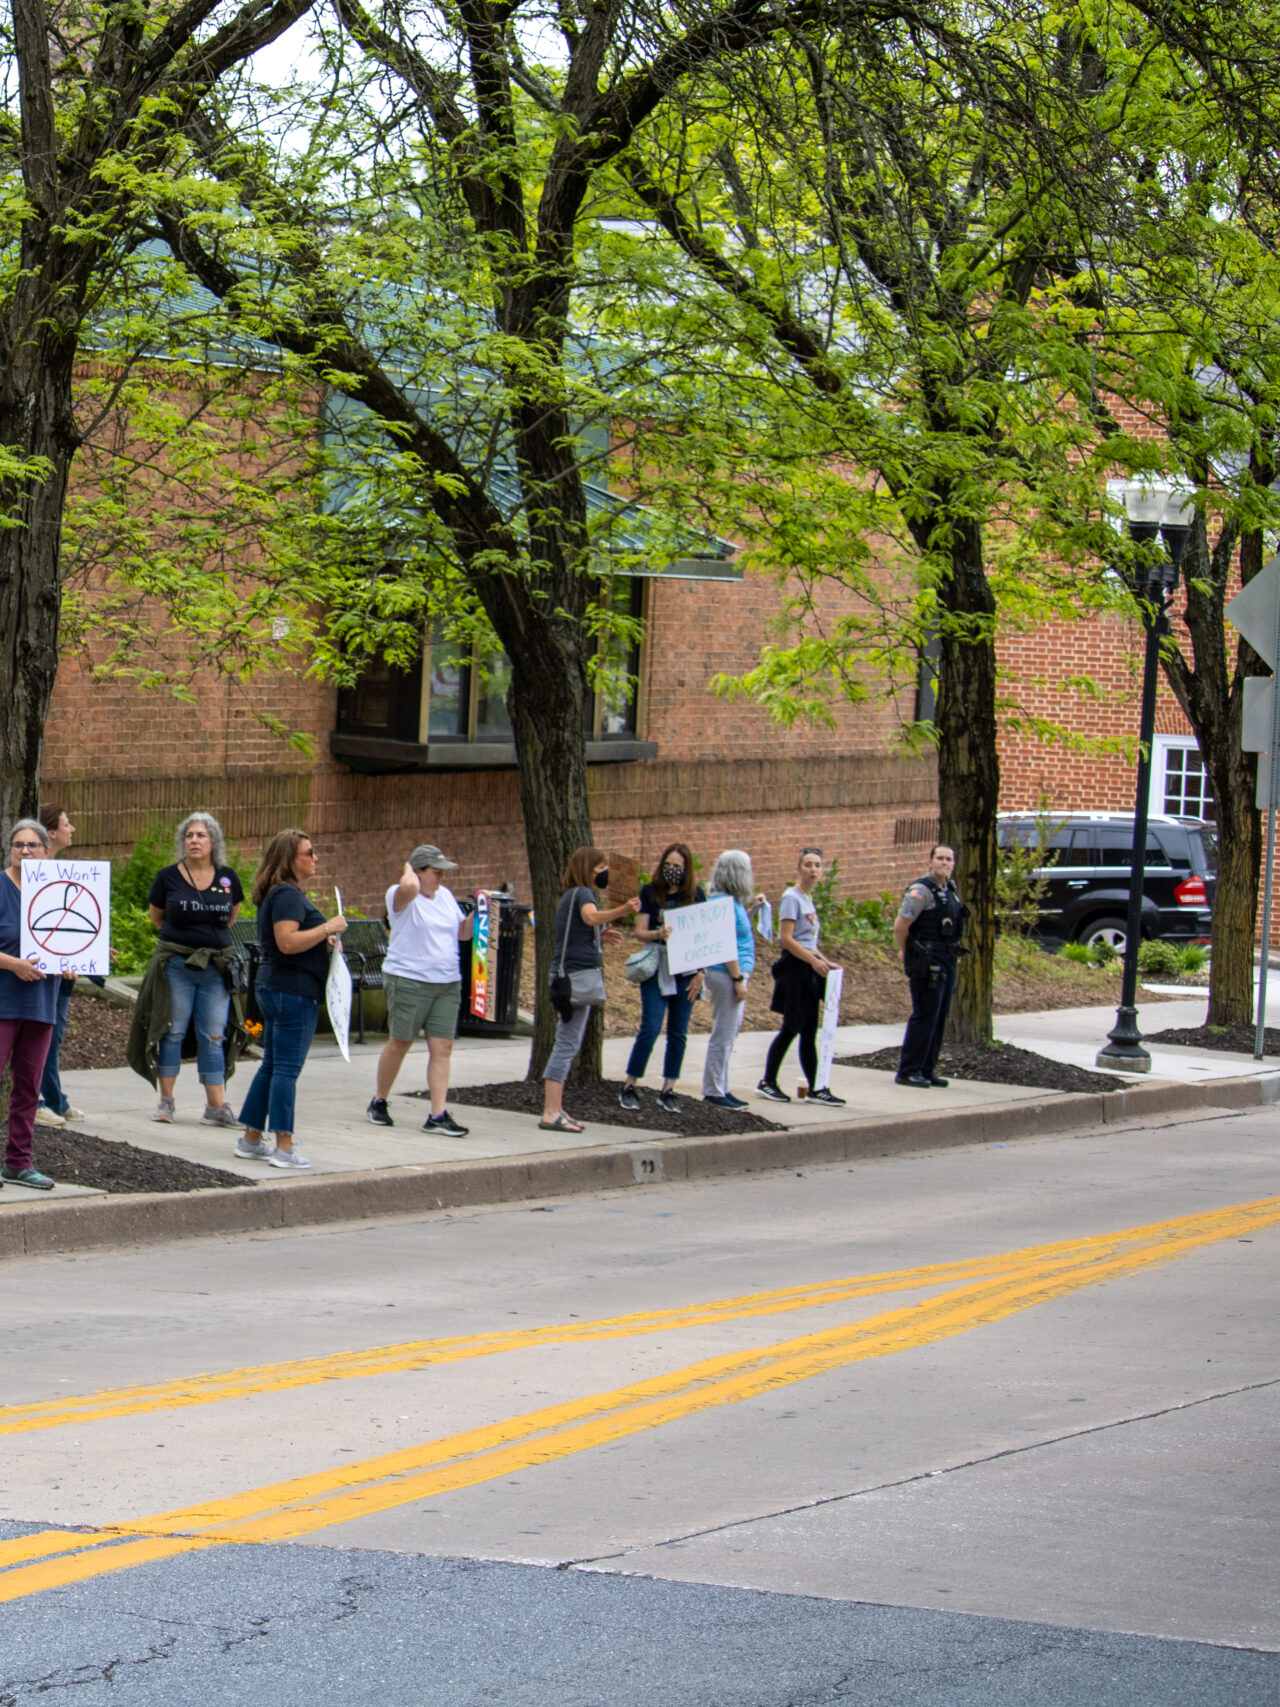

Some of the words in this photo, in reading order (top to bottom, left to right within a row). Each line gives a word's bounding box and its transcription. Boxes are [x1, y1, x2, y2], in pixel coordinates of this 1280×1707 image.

[24, 862, 48, 883] We
[57, 863, 100, 882] Won't
[477, 892, 489, 963] KIND
[60, 957, 97, 974] Back
[474, 979, 487, 1015] BE
